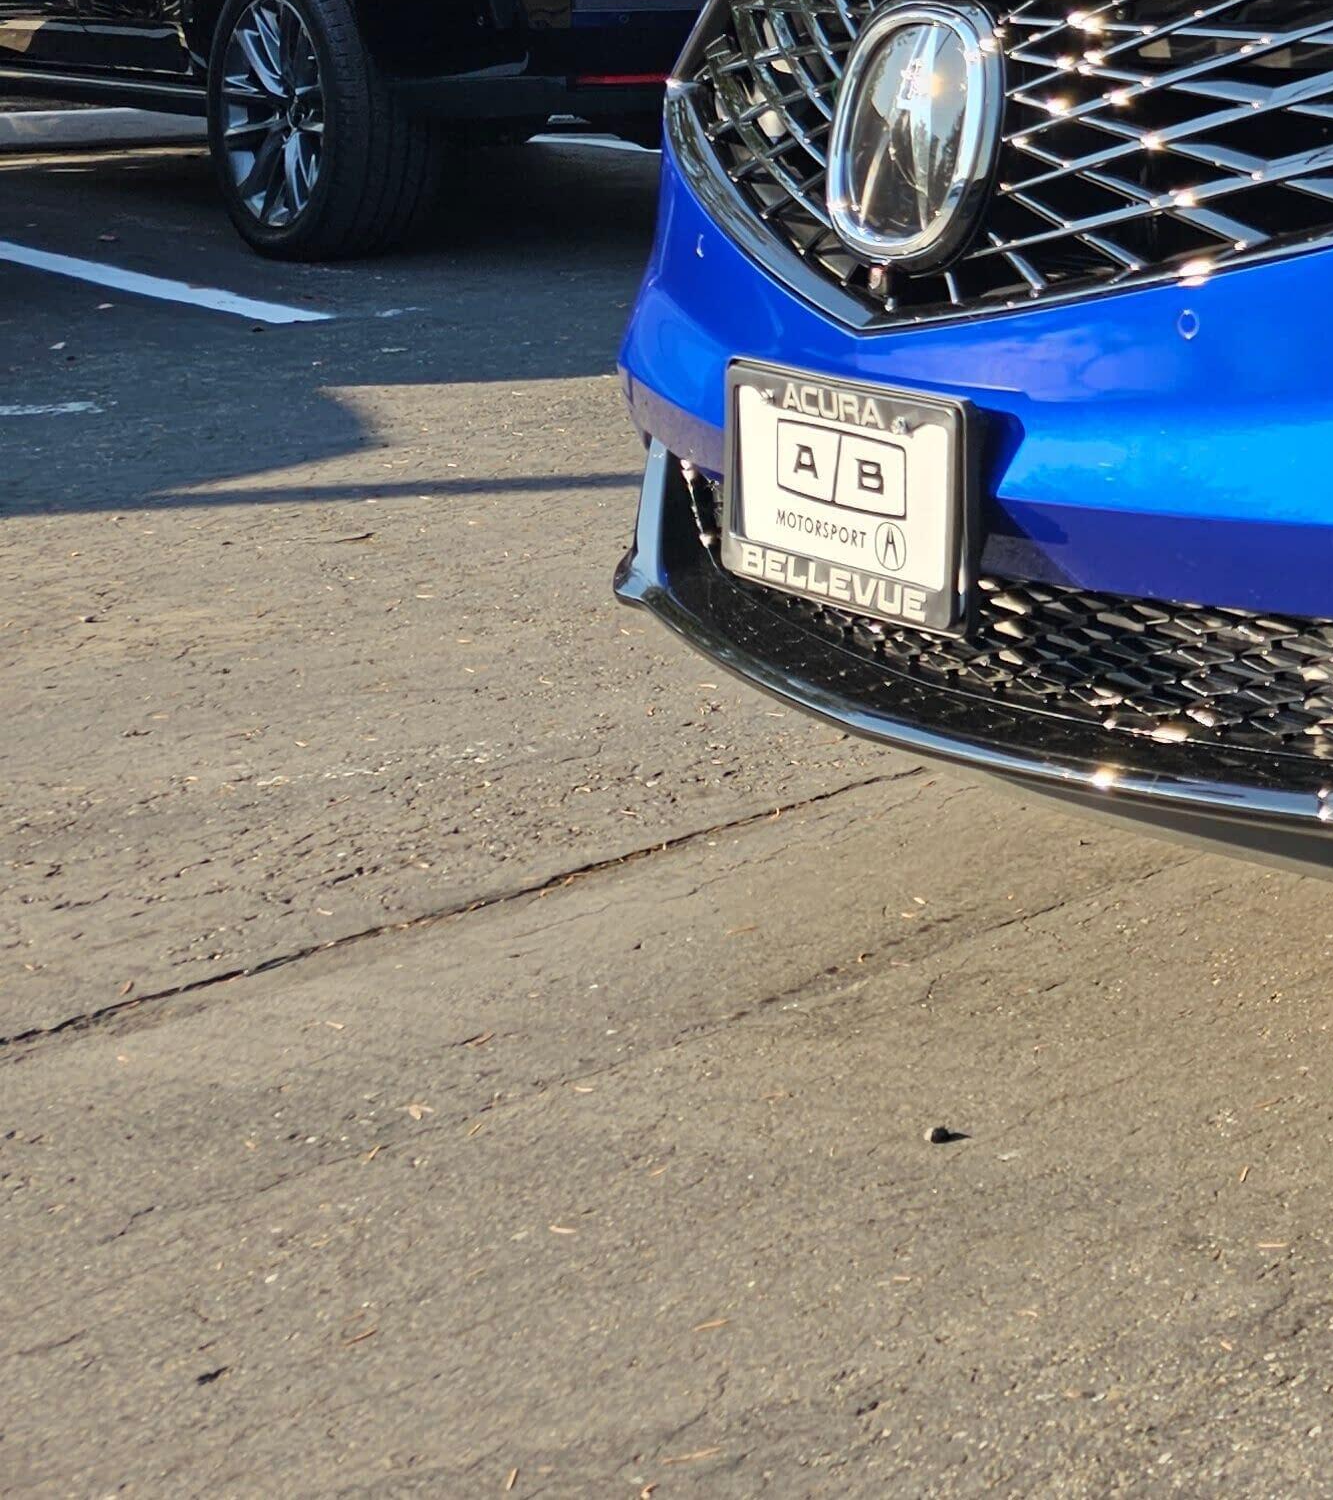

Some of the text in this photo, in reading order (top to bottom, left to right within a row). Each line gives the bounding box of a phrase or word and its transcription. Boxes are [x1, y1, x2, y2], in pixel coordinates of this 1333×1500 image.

[782, 382, 885, 429] ACURA
[793, 443, 884, 495] A B
[776, 508, 867, 550] MOTORSPORT
[741, 544, 927, 623] BELLEVUE
